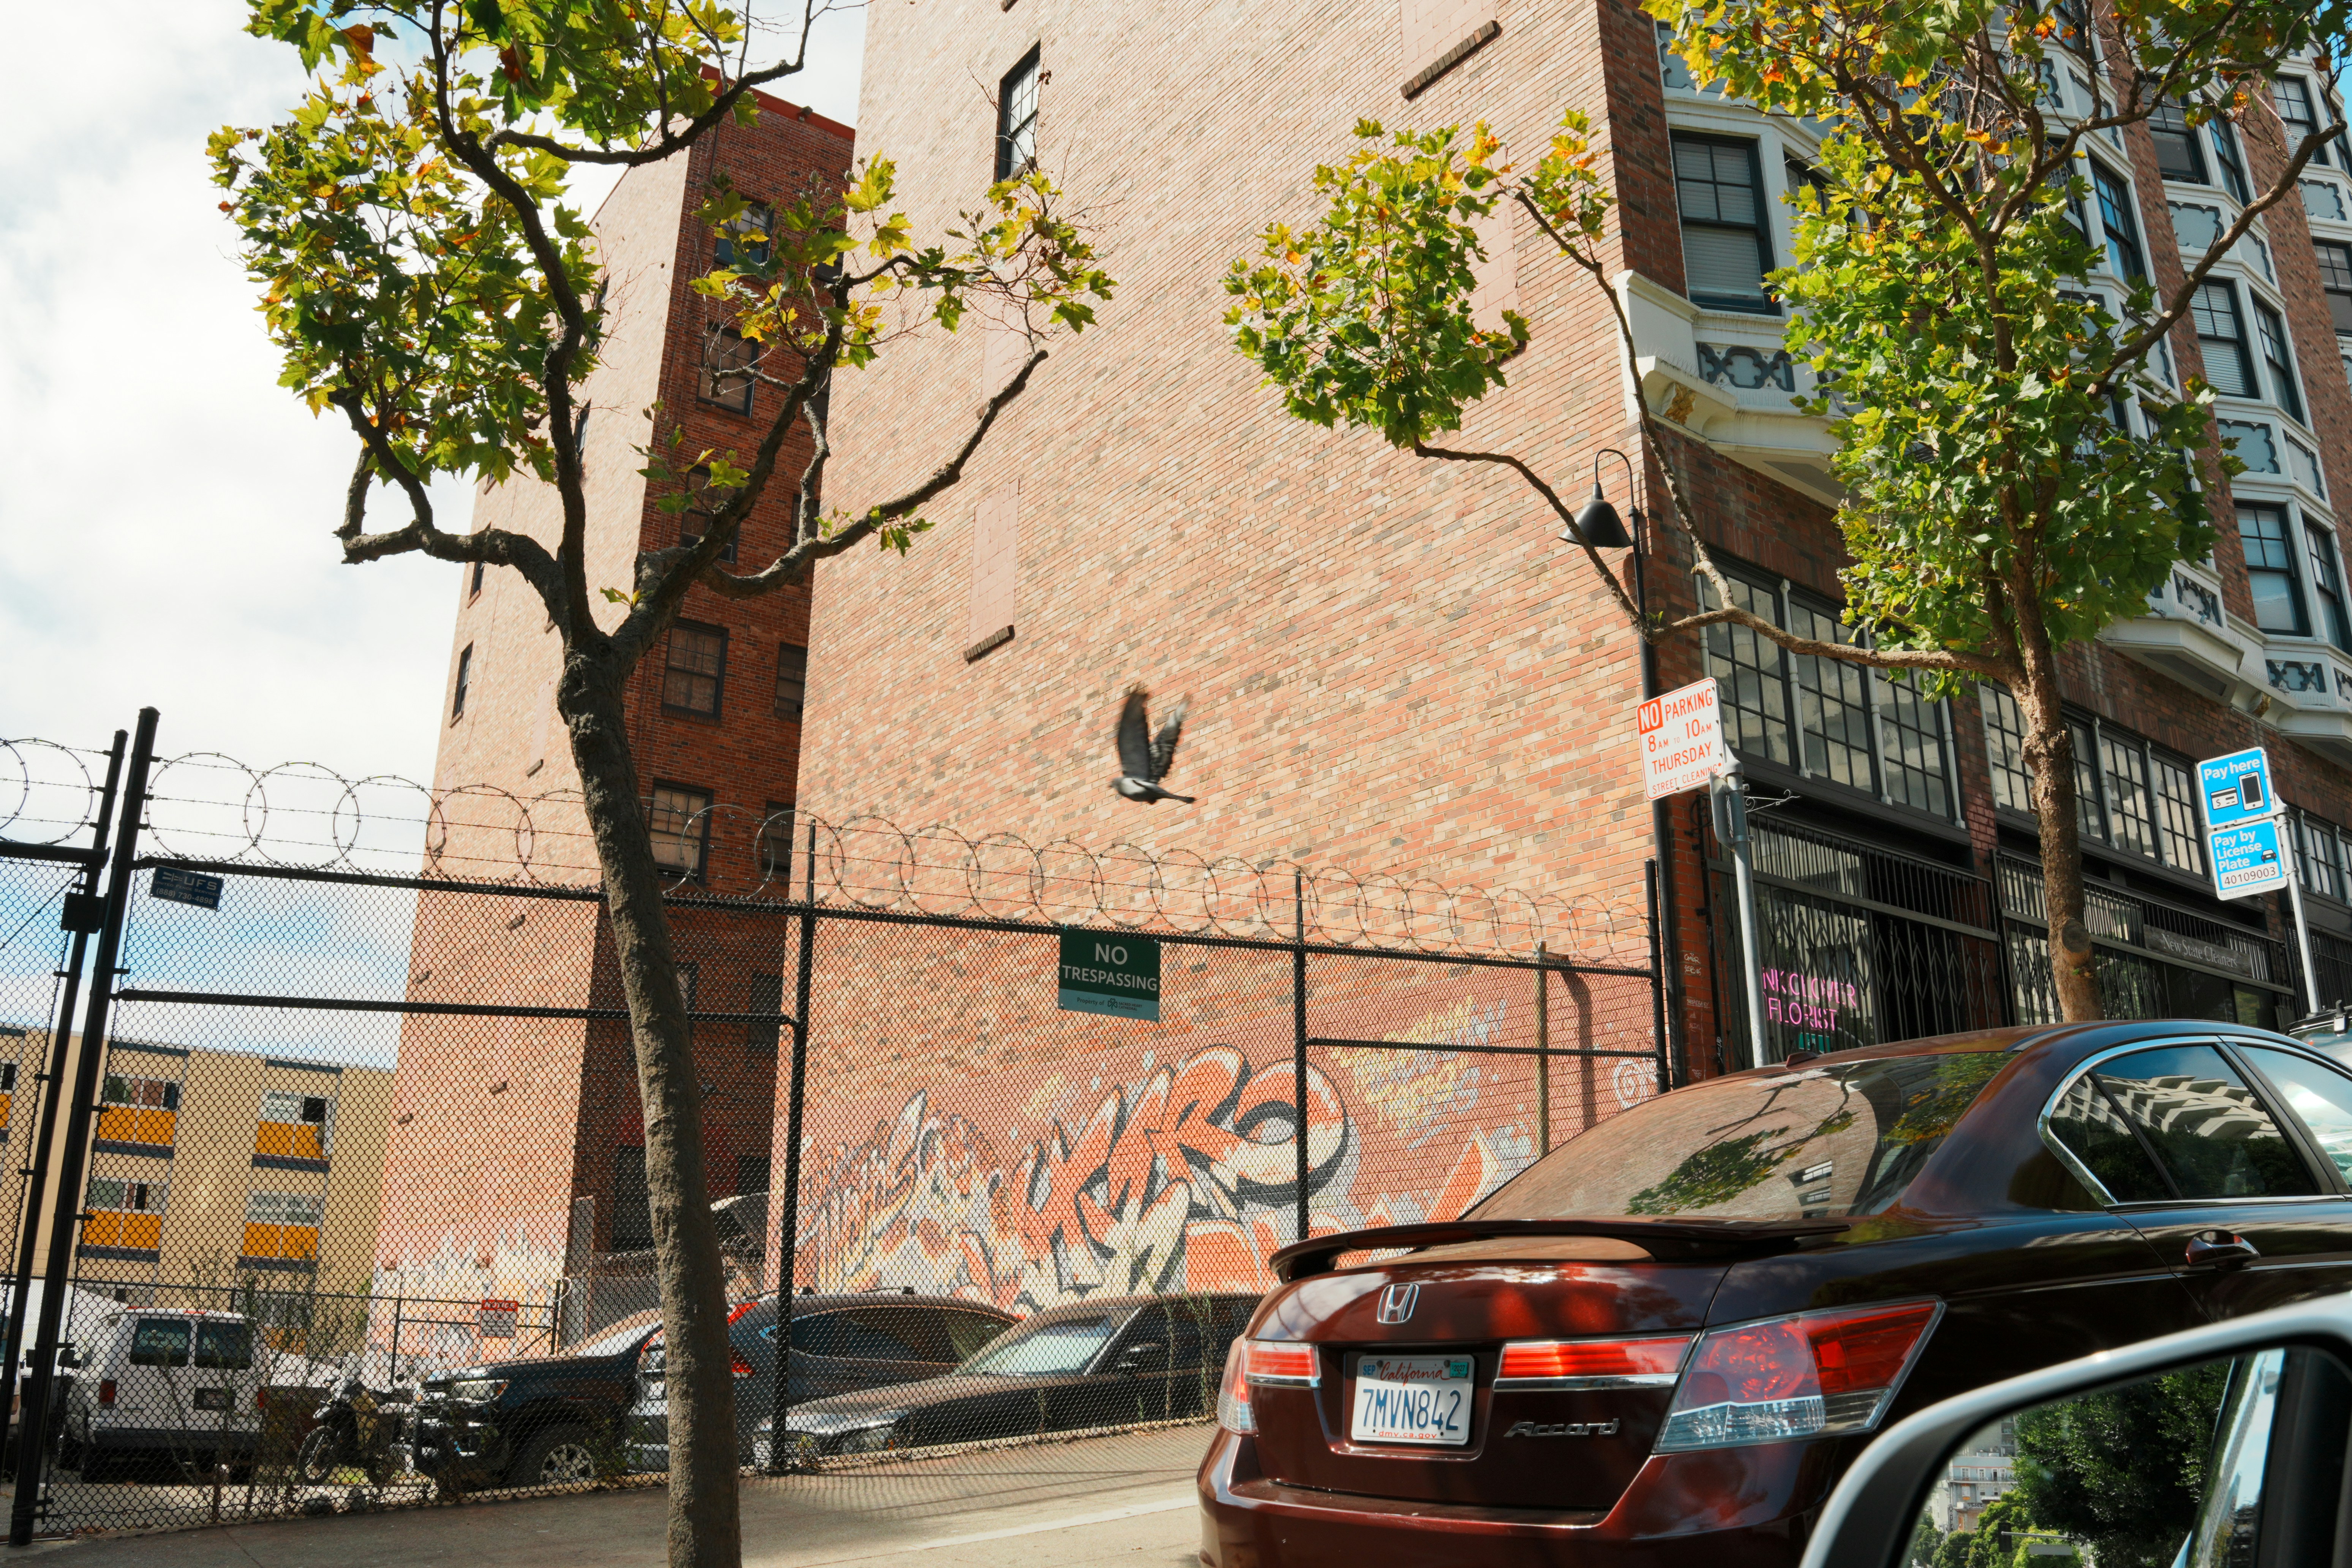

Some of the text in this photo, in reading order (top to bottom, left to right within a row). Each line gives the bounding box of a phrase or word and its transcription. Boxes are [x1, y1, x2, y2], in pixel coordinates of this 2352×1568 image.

[1640, 689, 1712, 731] NO PARKING
[1652, 741, 1712, 775] THURSDAY
[1652, 763, 1718, 794] STREET CLEANING
[2203, 759, 2260, 780] Pay here
[2214, 831, 2256, 847] Pay by
[2216, 842, 2262, 860] License
[2218, 858, 2250, 872] Plate
[184, 876, 217, 891] UFS
[2224, 867, 2276, 885] 40109003
[2261, 880, 2284, 888] paystation
[156, 887, 213, 904] (888) 730-4898
[1095, 943, 1128, 965] NO
[2161, 933, 2237, 968] New State Cleaners
[1062, 965, 1157, 991] TRESPASSING
[1789, 974, 1856, 1007] CLOVER
[1077, 997, 1098, 1006] Property
[1769, 997, 1837, 1031] FLORIST
[1363, 1364, 1376, 1376] SEP
[1380, 1361, 1450, 1387] California
[1363, 1388, 1461, 1430] 7MVN842
[1378, 1431, 1437, 1439] dmv.ca.gov
[1503, 1418, 1619, 1437] Accord
